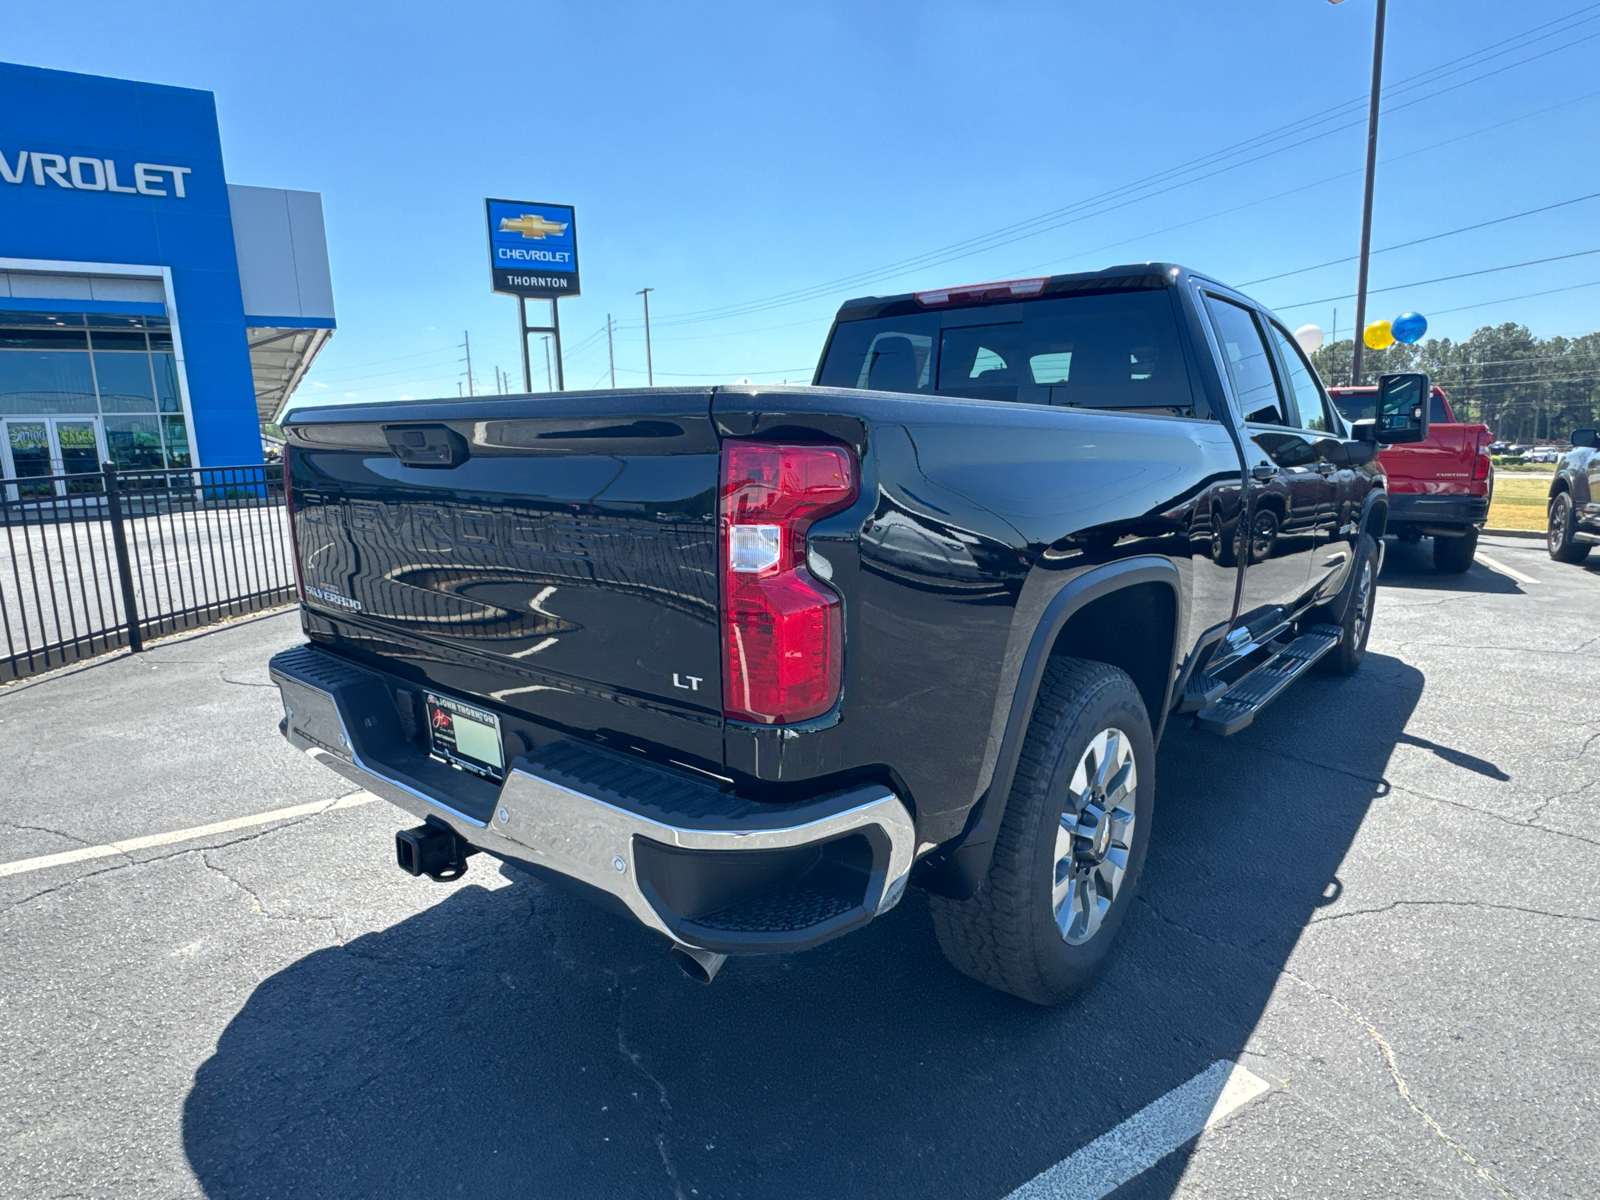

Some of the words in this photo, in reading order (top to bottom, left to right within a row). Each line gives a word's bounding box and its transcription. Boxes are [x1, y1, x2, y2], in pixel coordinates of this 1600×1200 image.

[498, 248, 571, 263] CHEVROLET
[506, 275, 568, 288] THORNTON
[302, 493, 660, 567] CHEVROLET
[305, 585, 362, 611] SILVERADO
[672, 672, 704, 691] LT
[439, 697, 457, 711] JOHN
[456, 704, 495, 725] THORNTON
